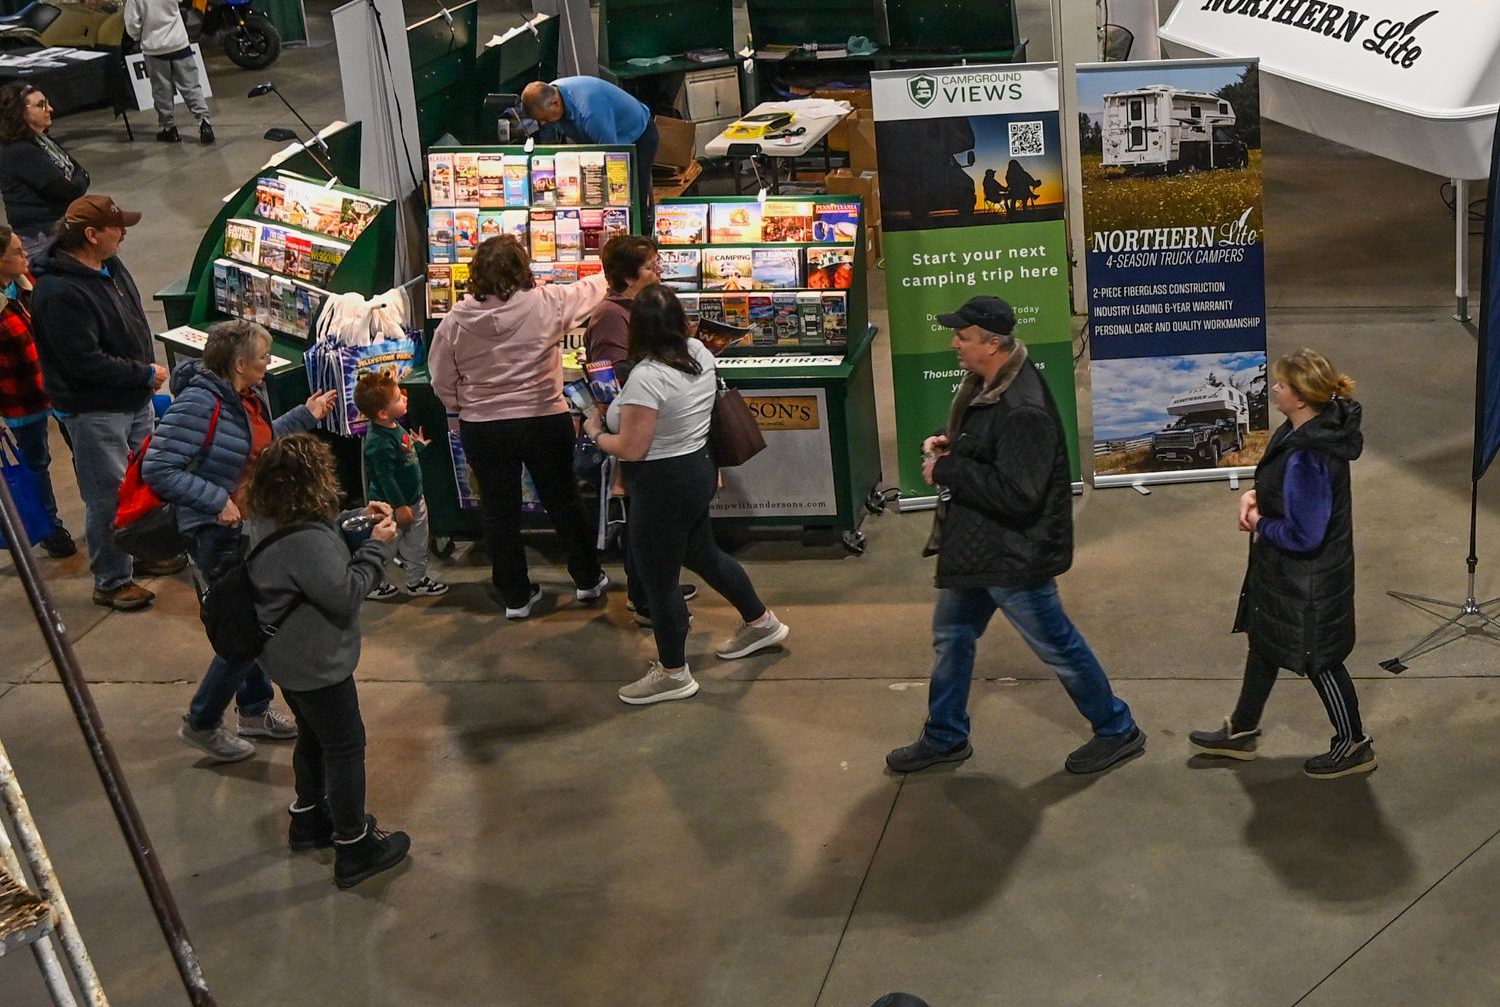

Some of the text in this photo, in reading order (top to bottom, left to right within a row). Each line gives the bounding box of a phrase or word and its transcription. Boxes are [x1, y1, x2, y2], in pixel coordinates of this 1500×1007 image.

[1363, 10, 1439, 69] Lite
[941, 73, 1021, 85] CAMPGROUND
[943, 84, 1022, 103] VIEWS
[1092, 206, 1258, 253] NORTHERN Lite
[912, 245, 1046, 266] Start your next
[1105, 248, 1245, 269] 4-SEASON TRUCK CAMPERS
[902, 266, 1058, 288] camping trip here
[1093, 281, 1226, 299] 2-PIECE FIBERGLASS CONSTRUCTION
[1013, 306, 1039, 315] Today
[1094, 300, 1233, 317] INDUSTRY LEADING 6-YEAR WARRANTY
[1094, 317, 1261, 336] PERSONAL CARE AND QUALITY WORKMANSHIP
[357, 354, 395, 368] JELLYSTONE
[923, 369, 968, 380] Thousan
[711, 500, 827, 511] ampwithandersons.com
